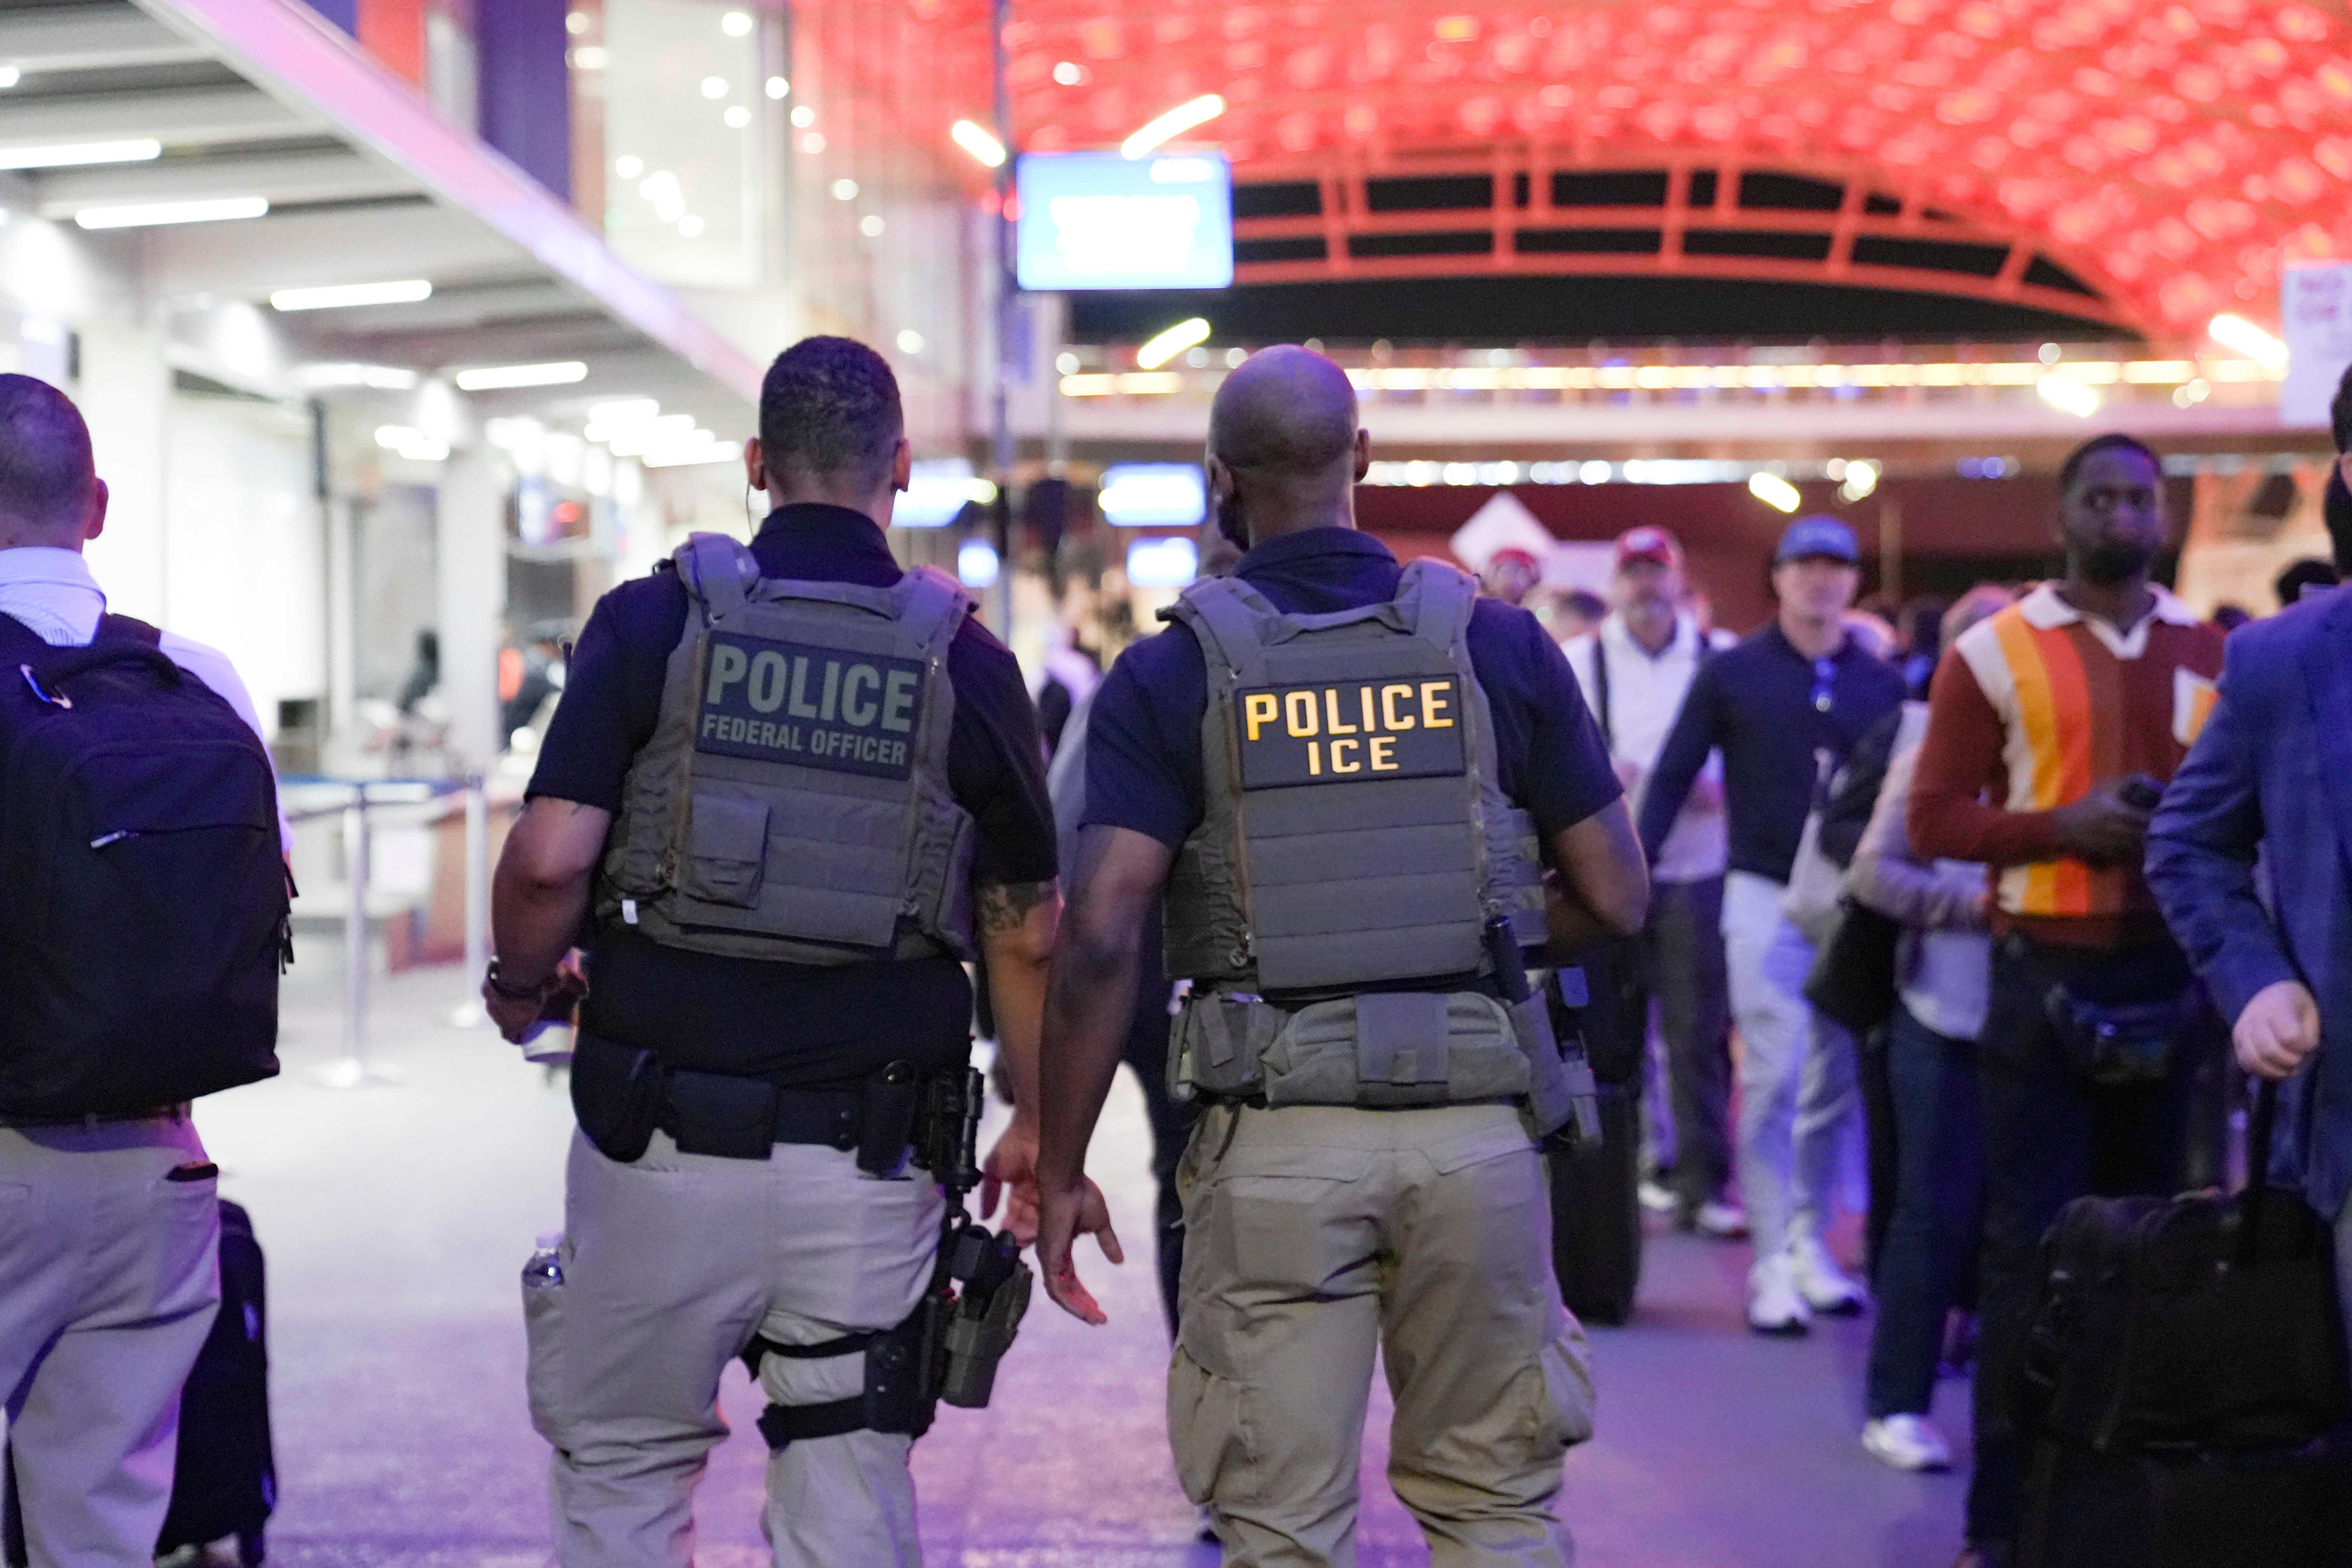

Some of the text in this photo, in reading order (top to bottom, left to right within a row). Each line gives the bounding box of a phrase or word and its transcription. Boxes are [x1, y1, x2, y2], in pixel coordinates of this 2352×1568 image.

[707, 645, 917, 733] POLICE
[1245, 682, 1453, 740] POLICE
[702, 714, 907, 766] FEDERAL OFFICER
[1308, 736, 1399, 775] ICE
